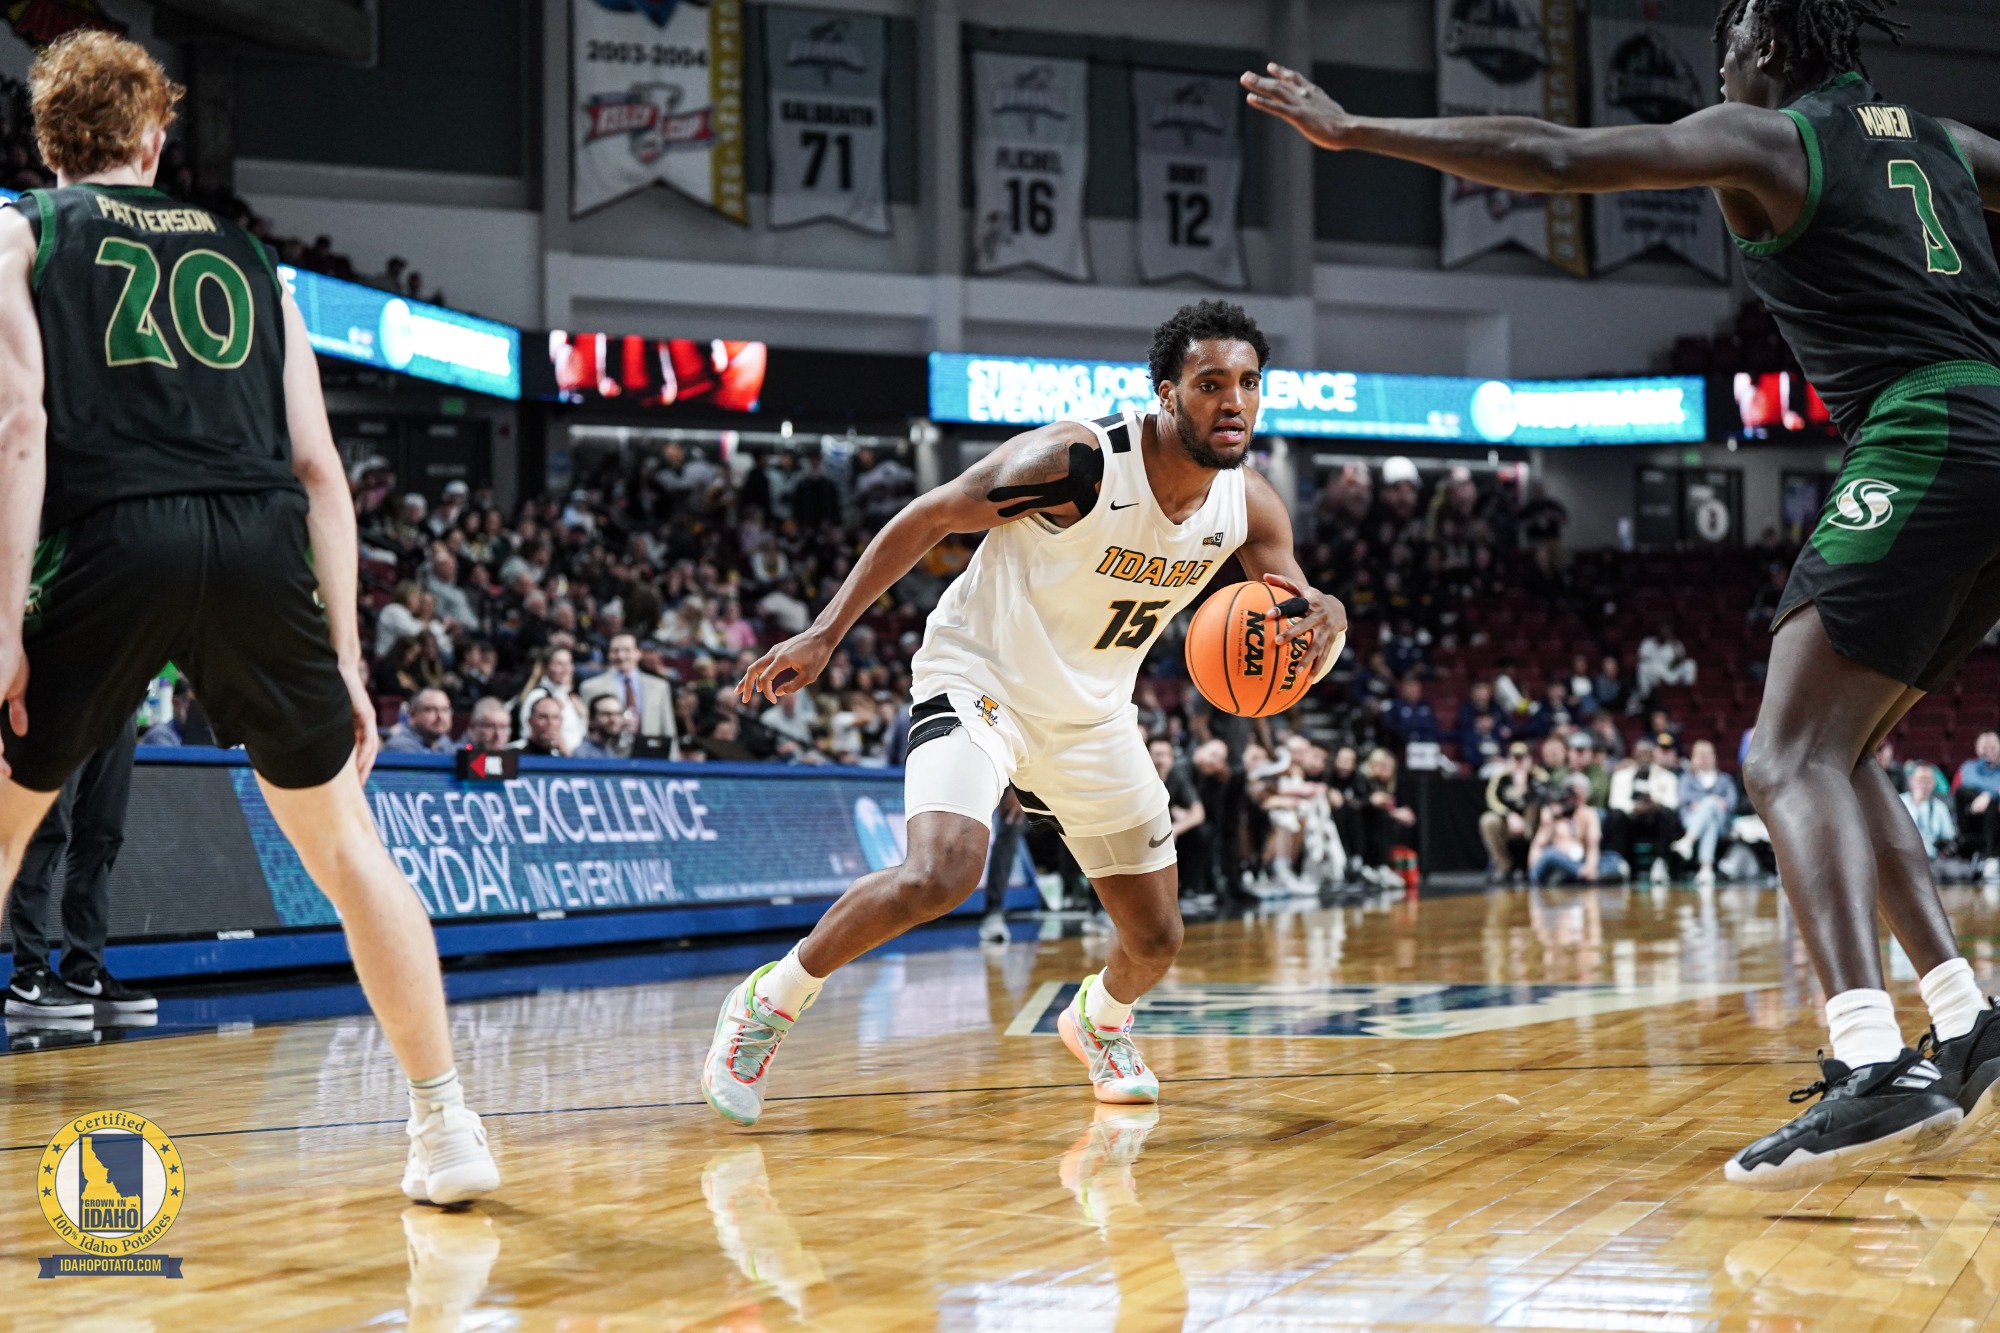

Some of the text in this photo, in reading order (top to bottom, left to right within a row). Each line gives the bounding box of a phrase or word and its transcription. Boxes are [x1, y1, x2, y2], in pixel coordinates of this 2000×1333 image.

[1857, 106, 1912, 138] MAWEIN
[801, 130, 853, 190] 71
[96, 195, 217, 233] PATTERSON
[1005, 178, 1055, 236] 16
[1165, 191, 1213, 248] 12
[95, 236, 254, 369] 20
[1093, 599, 1171, 650] 15
[1243, 610, 1266, 677] NCAA
[445, 791, 515, 845] FOR
[503, 777, 719, 845] EXCELLENCE
[524, 863, 559, 909] IN
[555, 860, 624, 907] EVERY
